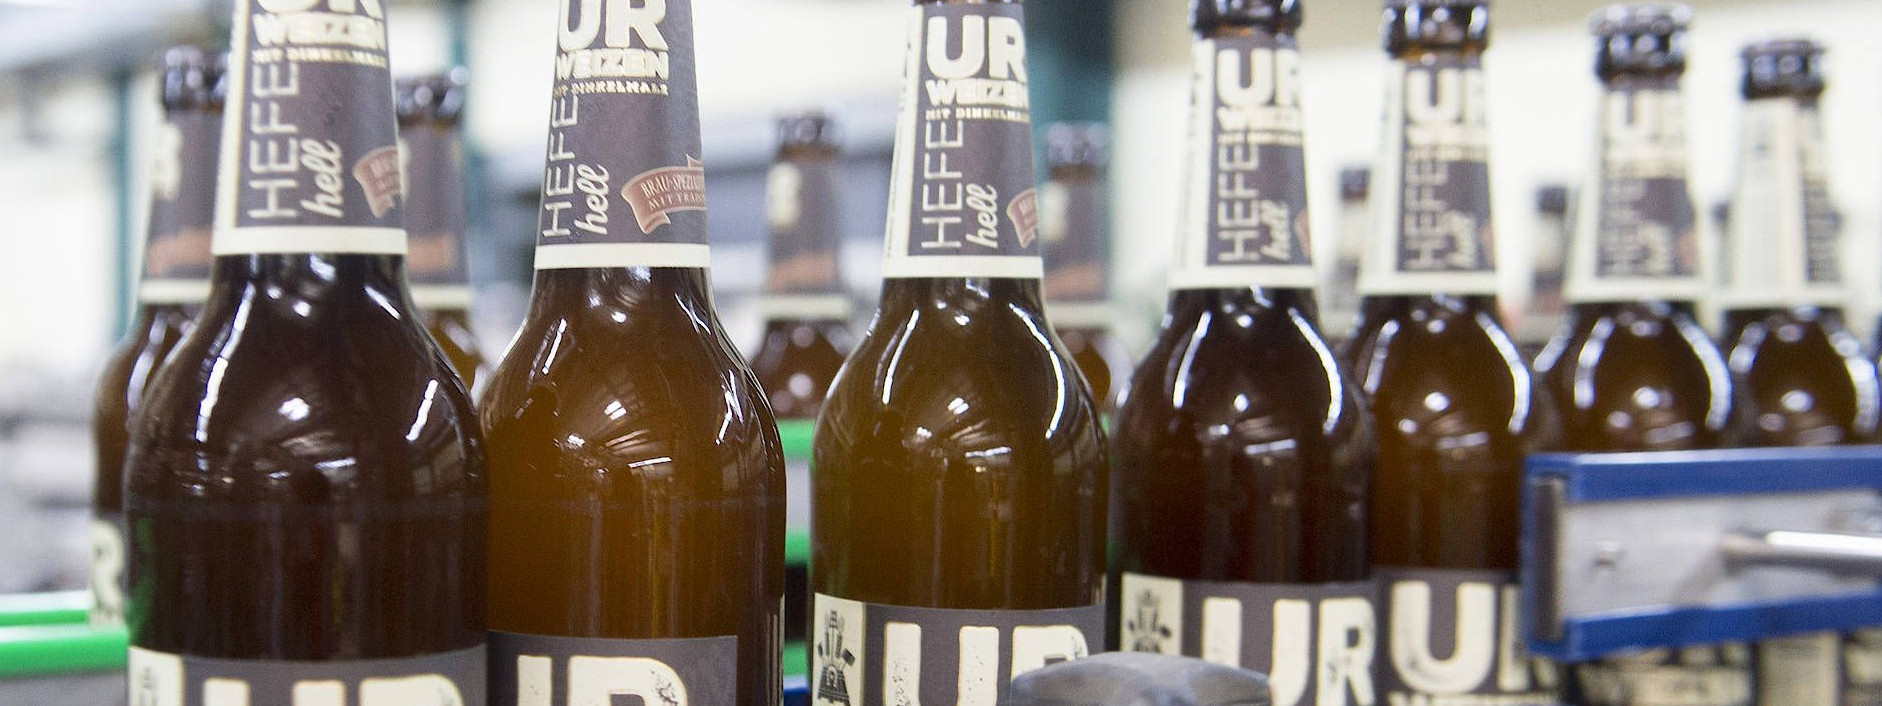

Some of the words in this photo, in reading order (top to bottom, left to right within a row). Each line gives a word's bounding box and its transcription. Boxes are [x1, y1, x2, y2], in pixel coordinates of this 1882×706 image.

[556, 48, 669, 81] WEIZEN
[558, 0, 669, 52] UR
[926, 15, 1028, 79] UR
[247, 62, 298, 218] HEFE
[300, 138, 344, 219] hell
[542, 95, 579, 238] HEFE
[574, 164, 610, 235] hell
[921, 121, 963, 248] HEFE
[966, 183, 998, 248] hell
[1218, 144, 1260, 262] HEFE
[1203, 597, 1377, 706] UR
